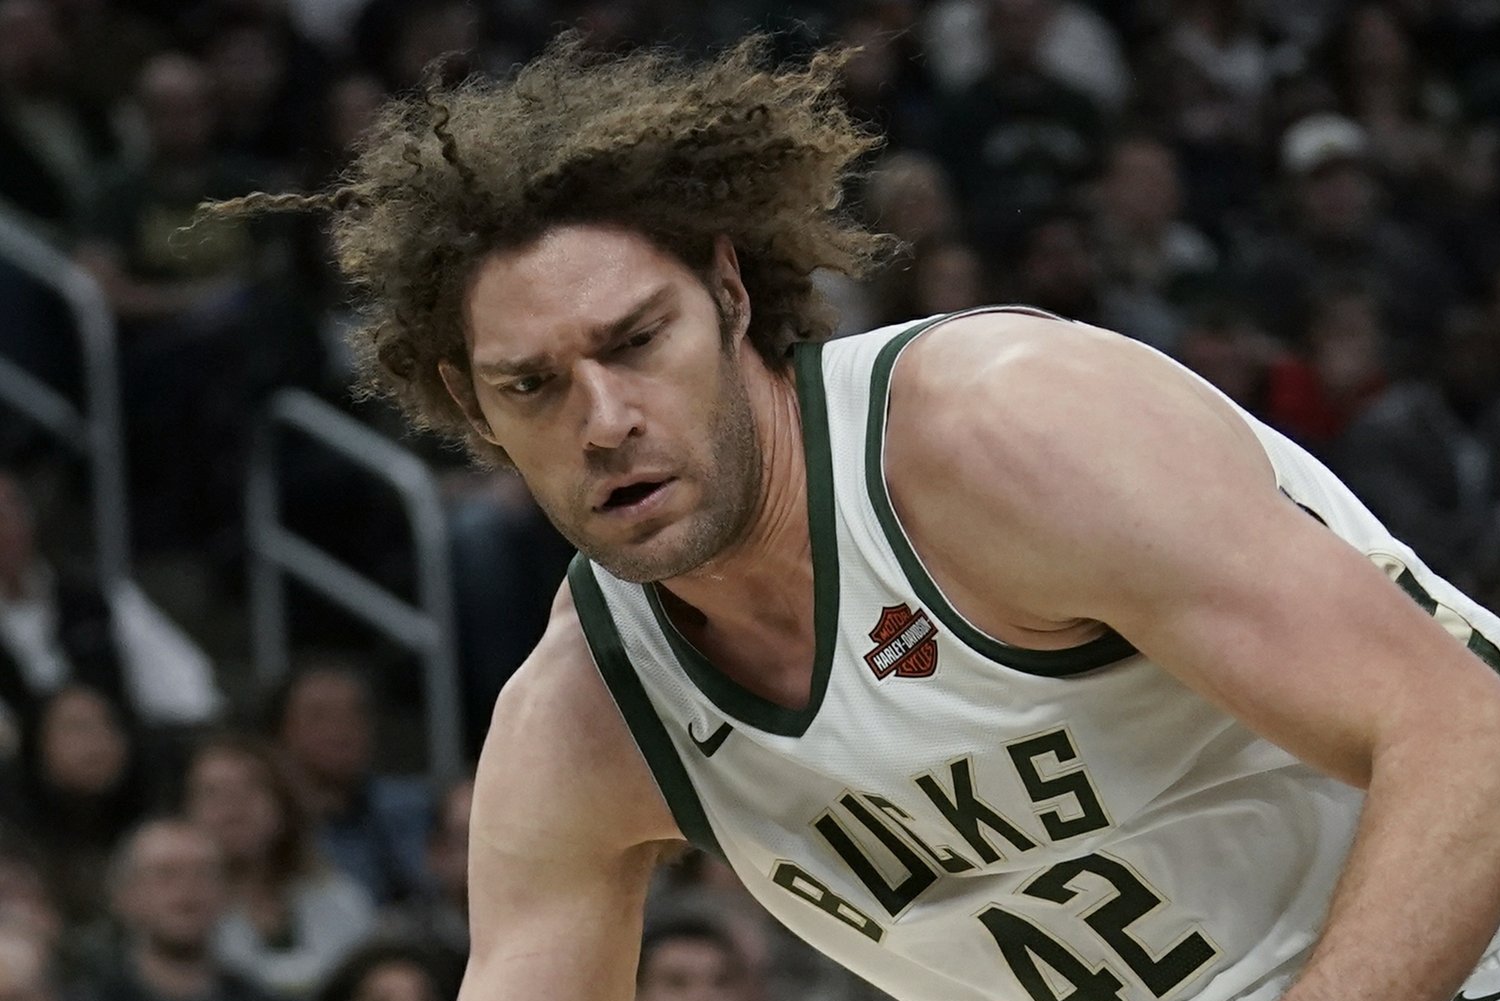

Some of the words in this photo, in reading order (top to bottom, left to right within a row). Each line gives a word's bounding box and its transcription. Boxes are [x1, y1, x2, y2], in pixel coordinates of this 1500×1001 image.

[872, 616, 932, 672] HARLEY-DAVIDSON
[879, 611, 909, 641] MOTOR
[768, 725, 1114, 946] BUCKS
